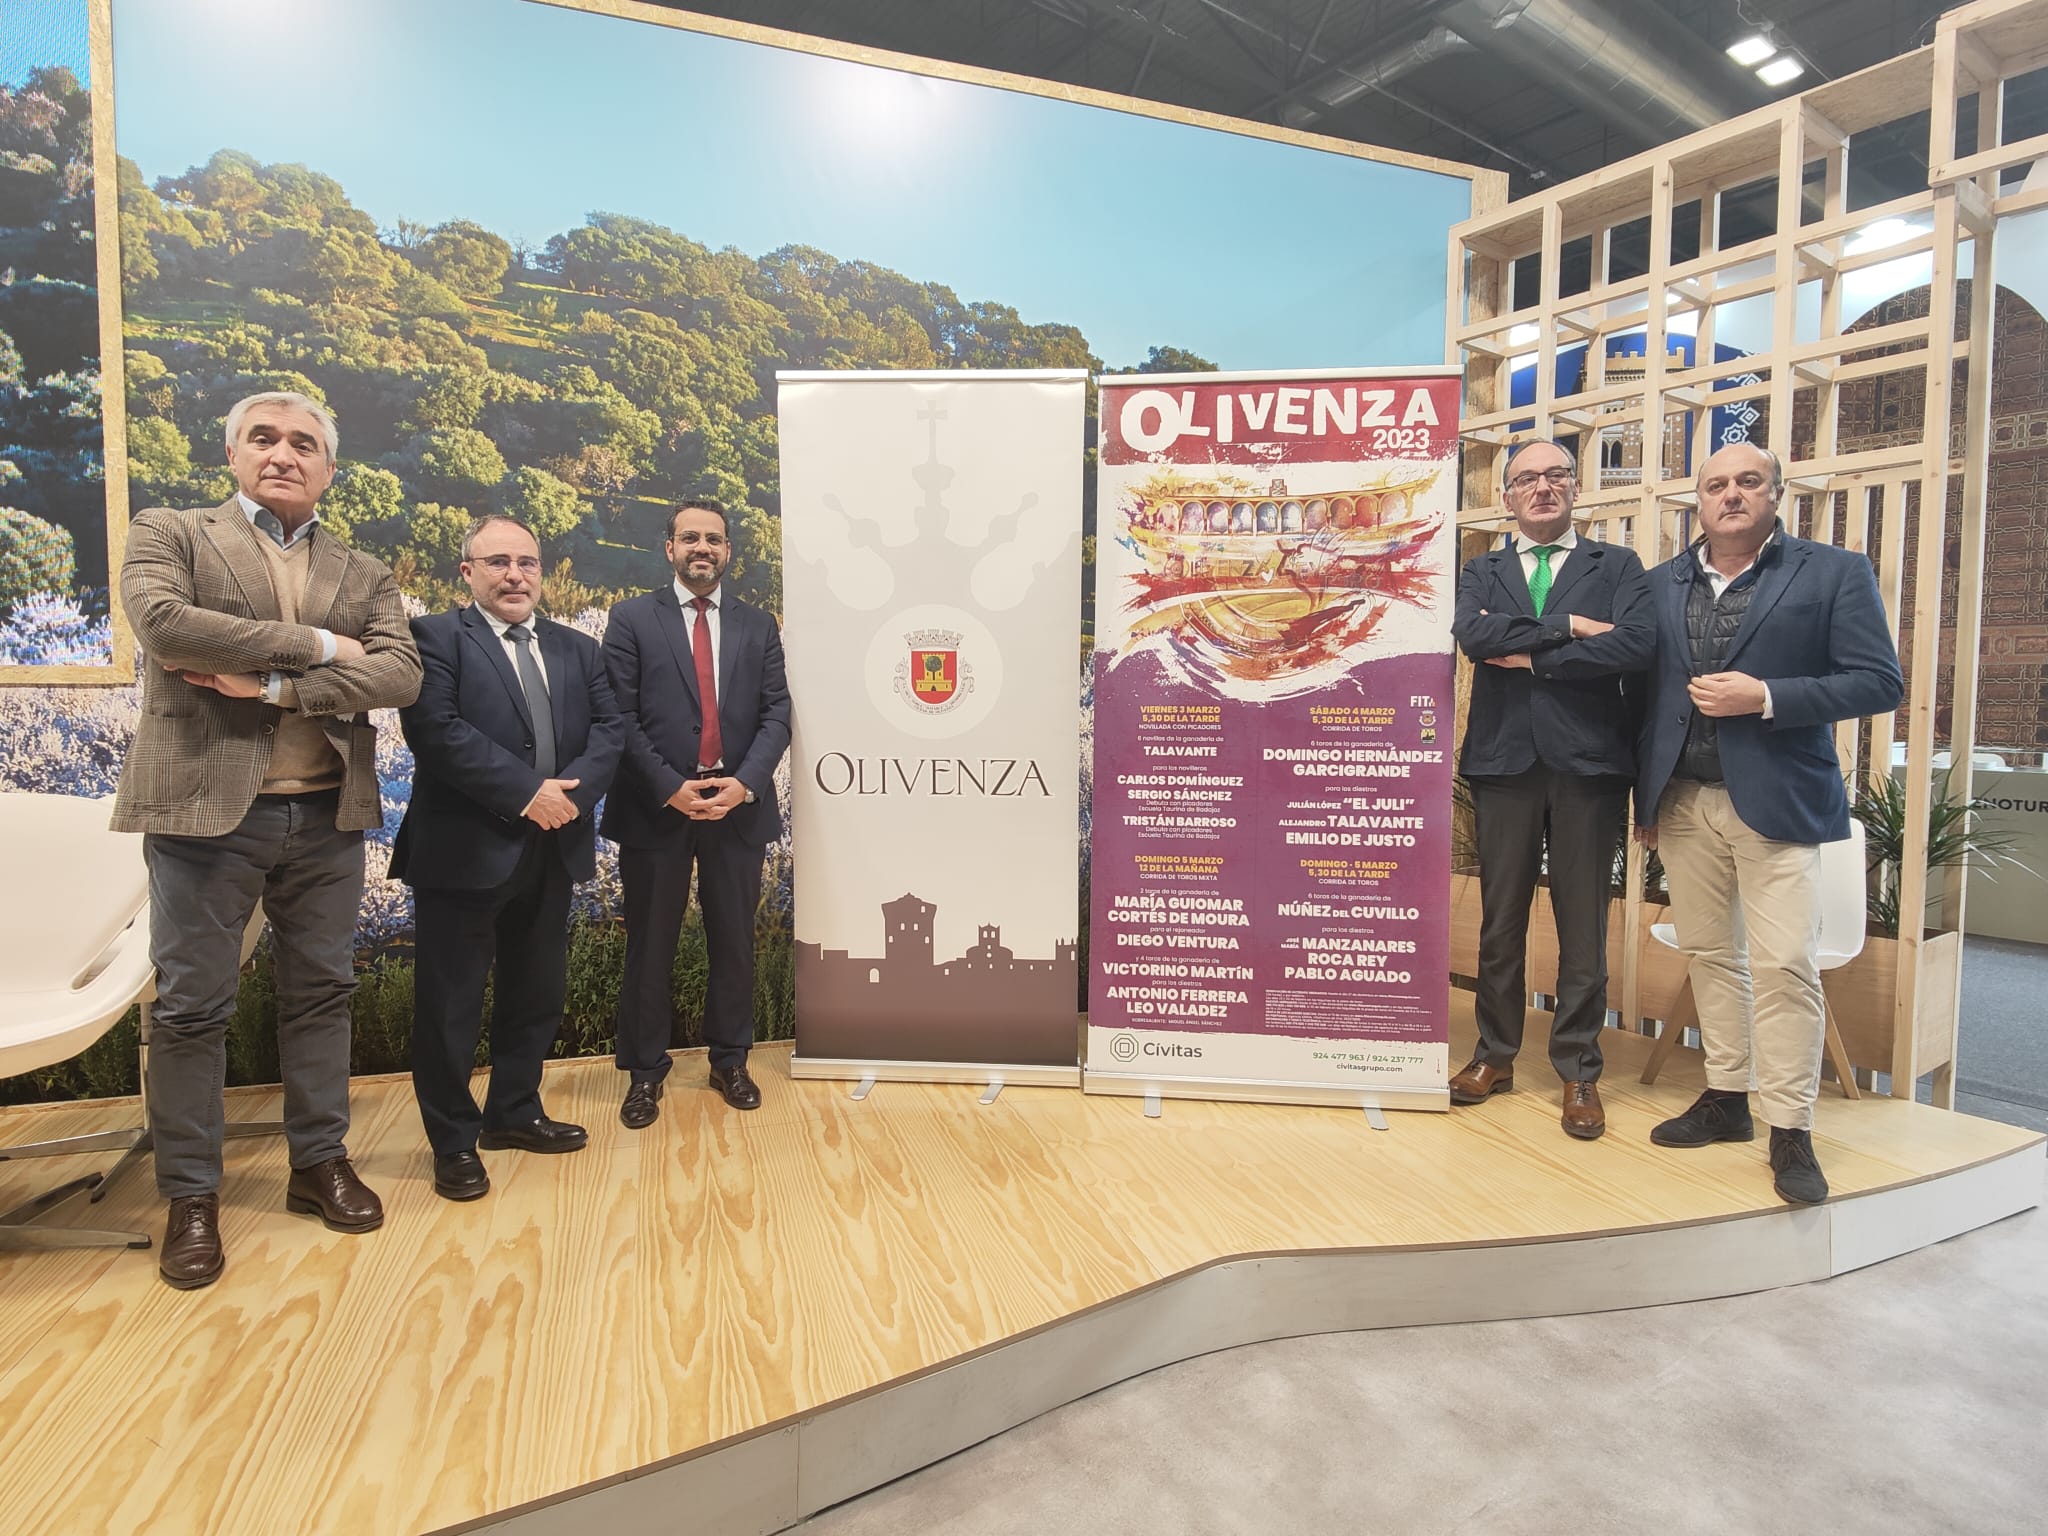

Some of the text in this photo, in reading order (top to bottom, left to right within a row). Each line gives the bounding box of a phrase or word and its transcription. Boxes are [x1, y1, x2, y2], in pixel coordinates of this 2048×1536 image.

[1120, 387, 1439, 452] OLIVENZA
[1372, 429, 1430, 449] 2023
[1187, 706, 1221, 714] MARZO
[1310, 705, 1395, 716] SÁBADO 4 MARZO
[1144, 746, 1217, 756] TALAVANTE
[1263, 746, 1442, 763] DOMINGO HERNÁNDEZ
[816, 752, 1054, 796] OLIVENZA
[1293, 764, 1410, 778] GARCIGRANDE
[1117, 773, 1243, 786] CARLOS DOMÍNGUEZ
[1128, 788, 1232, 801] SERGIO SÁNCHEZ
[1287, 800, 1316, 809] JULIÁN
[1317, 801, 1342, 809] LÓPEZ
[1123, 814, 1236, 827] TRISTÁN BARROSO
[1327, 815, 1424, 829] TALAVANTE
[1286, 832, 1416, 846] EMILIO DE JUSTO
[1135, 855, 1180, 863] DOMINGO
[1190, 856, 1224, 865] MARZO
[1300, 860, 1348, 868] DOMINGO
[1362, 861, 1398, 869] MARZO
[1139, 864, 1148, 872] 12
[1150, 864, 1161, 872] DE
[1175, 864, 1219, 873] MAÑANA
[1331, 869, 1343, 877] DE
[1345, 870, 1356, 878] LA
[1358, 870, 1390, 878] TARDE
[1115, 893, 1244, 911] MARÍA GUIOMAR
[1108, 907, 1250, 926] CORTÉS DE MOURA
[1278, 900, 1419, 920] NÚÑEZ DEL CUVILLO
[1117, 933, 1239, 949] DIEGO VENTURA
[1302, 937, 1416, 953] MANZANARES
[1308, 952, 1388, 967] ROCA REY
[1103, 962, 1188, 977] VICTORINO
[1285, 966, 1411, 983] PABLO AGUADO
[1106, 986, 1248, 1003] ANTONIO FERRERA
[1127, 1001, 1227, 1017] LEO VALADEZ
[1143, 1042, 1202, 1058] Cívitas
